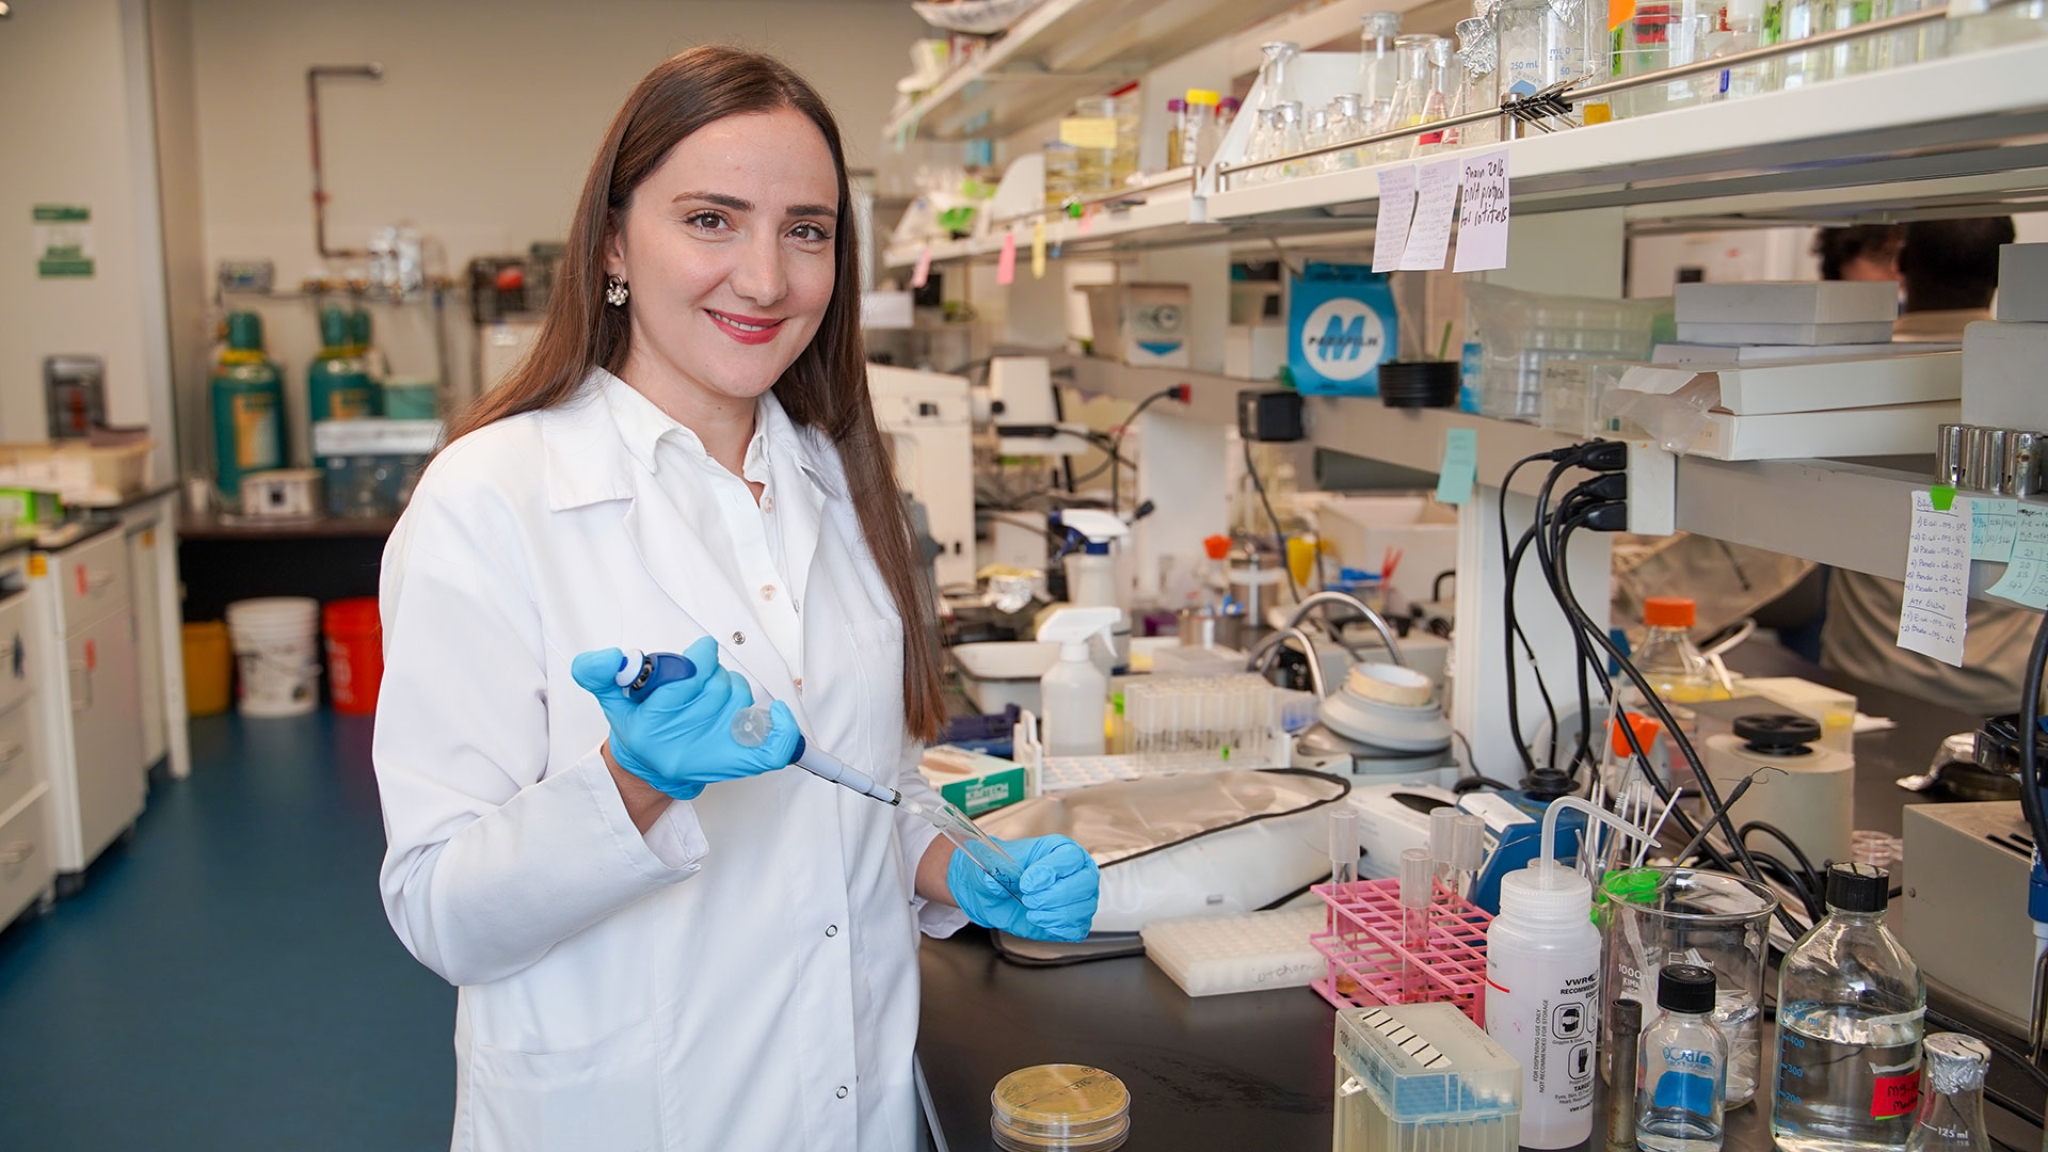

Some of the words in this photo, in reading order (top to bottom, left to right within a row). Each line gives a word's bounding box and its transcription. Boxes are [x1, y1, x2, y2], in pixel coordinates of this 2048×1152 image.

[1510, 61, 1524, 71] 250
[1525, 60, 1539, 69] mL
[1560, 66, 1571, 76] 50
[1488, 158, 1505, 177] 2016
[1464, 181, 1480, 203] DNA
[1565, 977, 1588, 986] VWR
[1808, 1017, 1820, 1026] ml
[1789, 1036, 1805, 1049] 400
[1787, 1063, 1804, 1078] 300
[1785, 1092, 1802, 1106] 200
[1937, 1126, 1955, 1138] 125
[1957, 1130, 1968, 1138] ml
